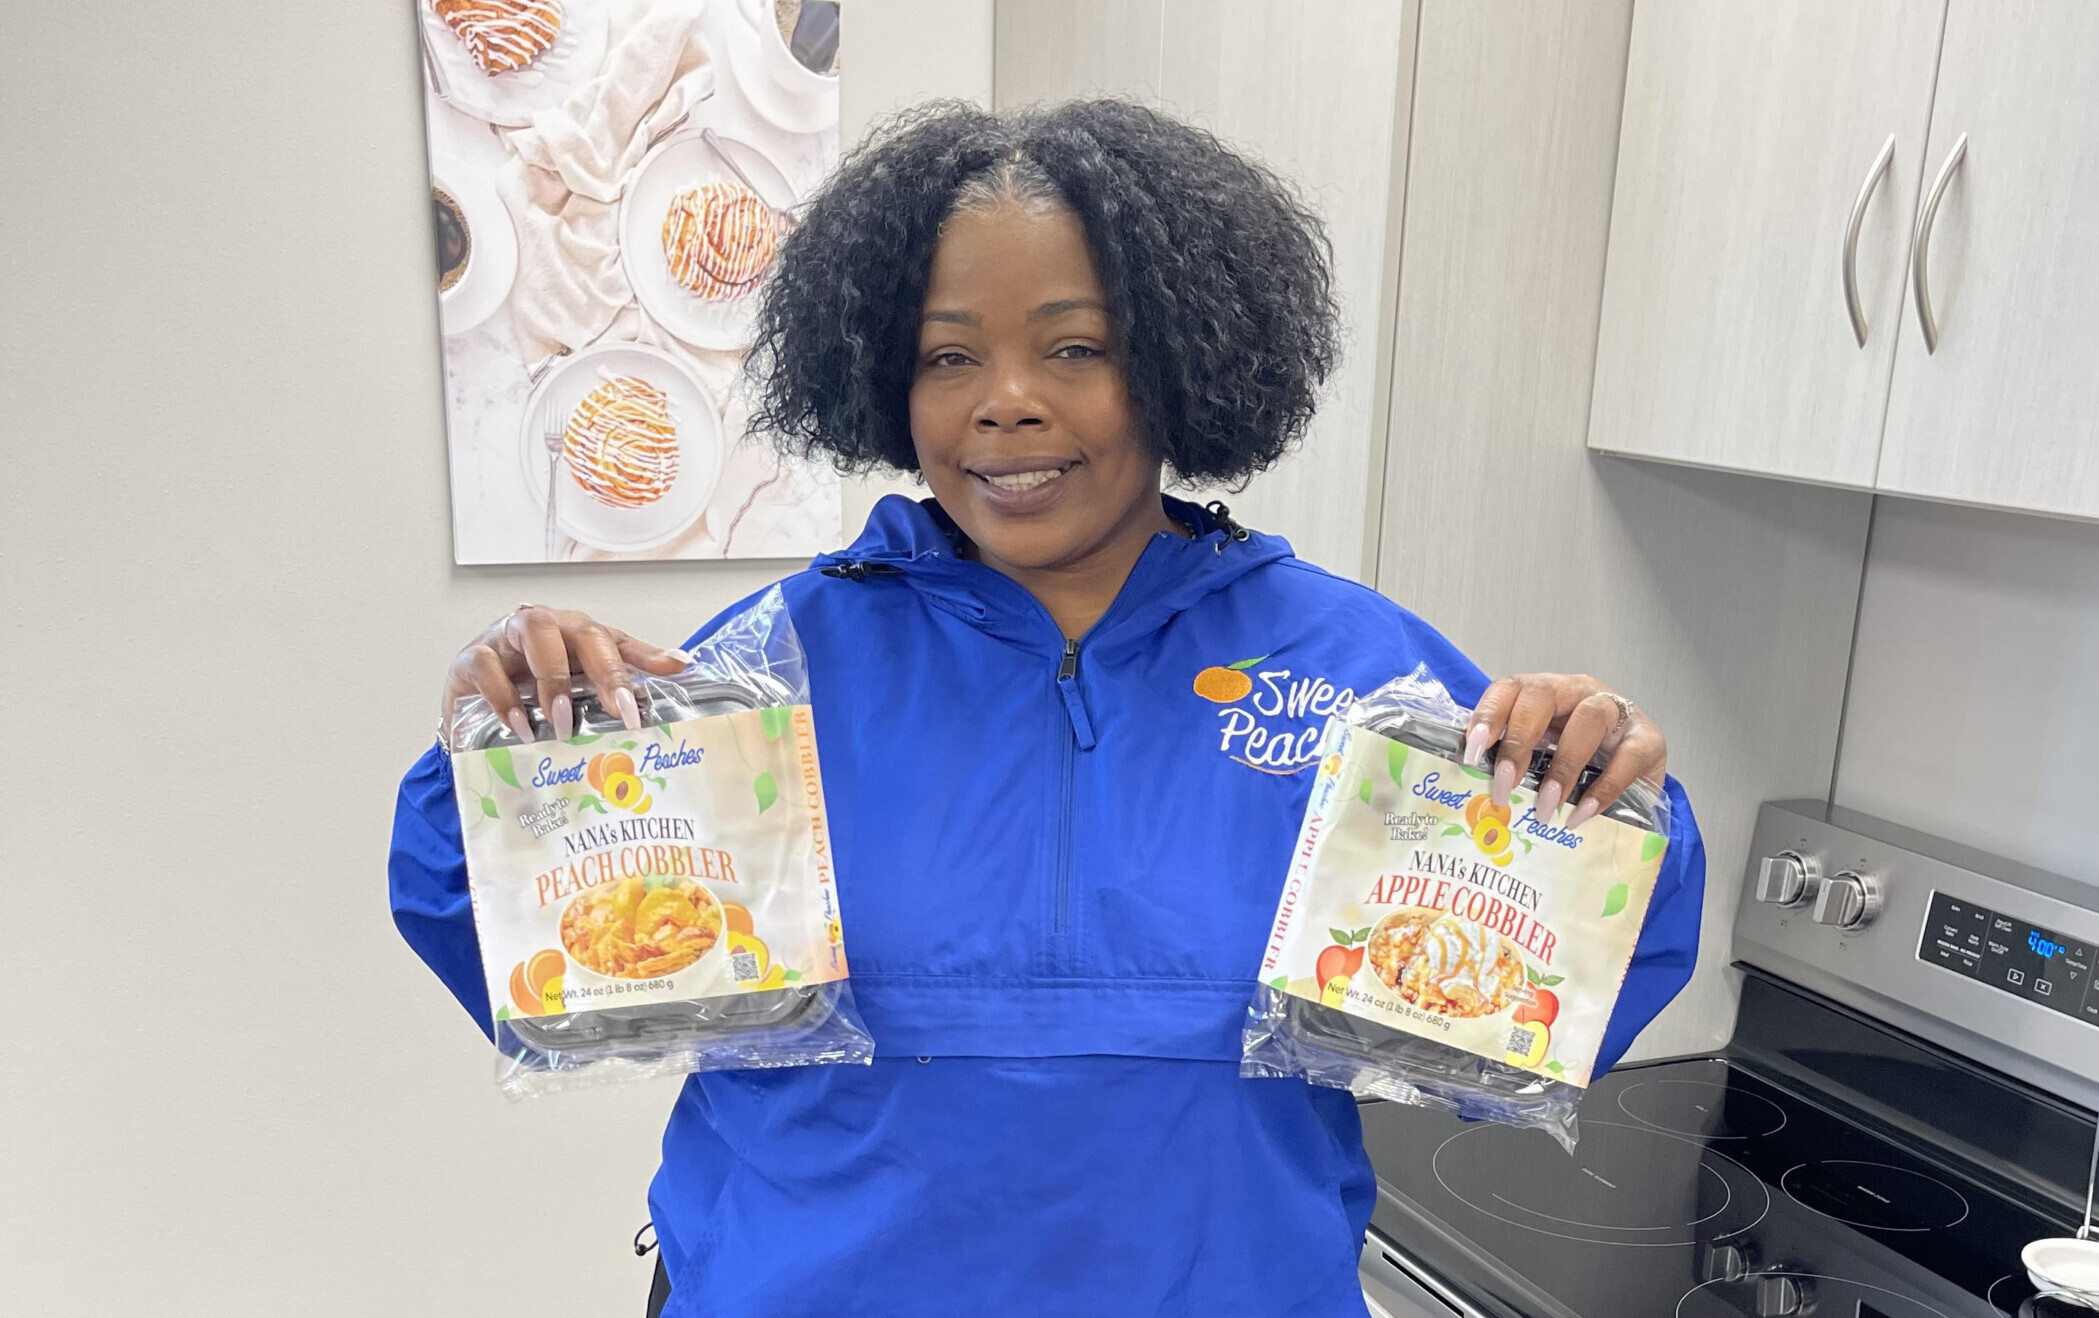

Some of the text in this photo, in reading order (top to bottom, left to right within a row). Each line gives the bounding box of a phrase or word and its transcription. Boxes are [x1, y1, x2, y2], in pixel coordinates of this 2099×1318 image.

[1253, 670, 1355, 718] Swee
[532, 739, 705, 788] Sweet Peaches
[517, 797, 570, 829] Ready to
[793, 711, 830, 884] PEACH COBBLER
[1412, 771, 1472, 810] Sweet
[531, 810, 569, 839] Bake!
[563, 817, 695, 858] NANA's KITCHEN
[1384, 812, 1439, 830] Ready to
[1391, 826, 1429, 841] Bake!
[535, 845, 738, 908] PEACH COBBLER
[1263, 811, 1324, 971] APPLE COBBLER
[1408, 850, 1542, 912] NANA's KITCHEN
[1364, 874, 1556, 966] APPLE COBBLER
[545, 992, 562, 1002] Net
[581, 988, 592, 998] 24
[593, 988, 604, 997] oz
[615, 984, 625, 994] lb
[626, 983, 633, 993] 8
[648, 979, 665, 990] 680
[666, 980, 674, 990] g
[1327, 982, 1344, 995] Net
[1346, 987, 1361, 1000] Wt.
[1362, 995, 1373, 1005] 24
[1374, 999, 1386, 1008] oz
[1395, 1003, 1404, 1014] lb
[1405, 1006, 1412, 1016] 8
[1426, 1012, 1444, 1027] 680
[1443, 1020, 1451, 1032] g
